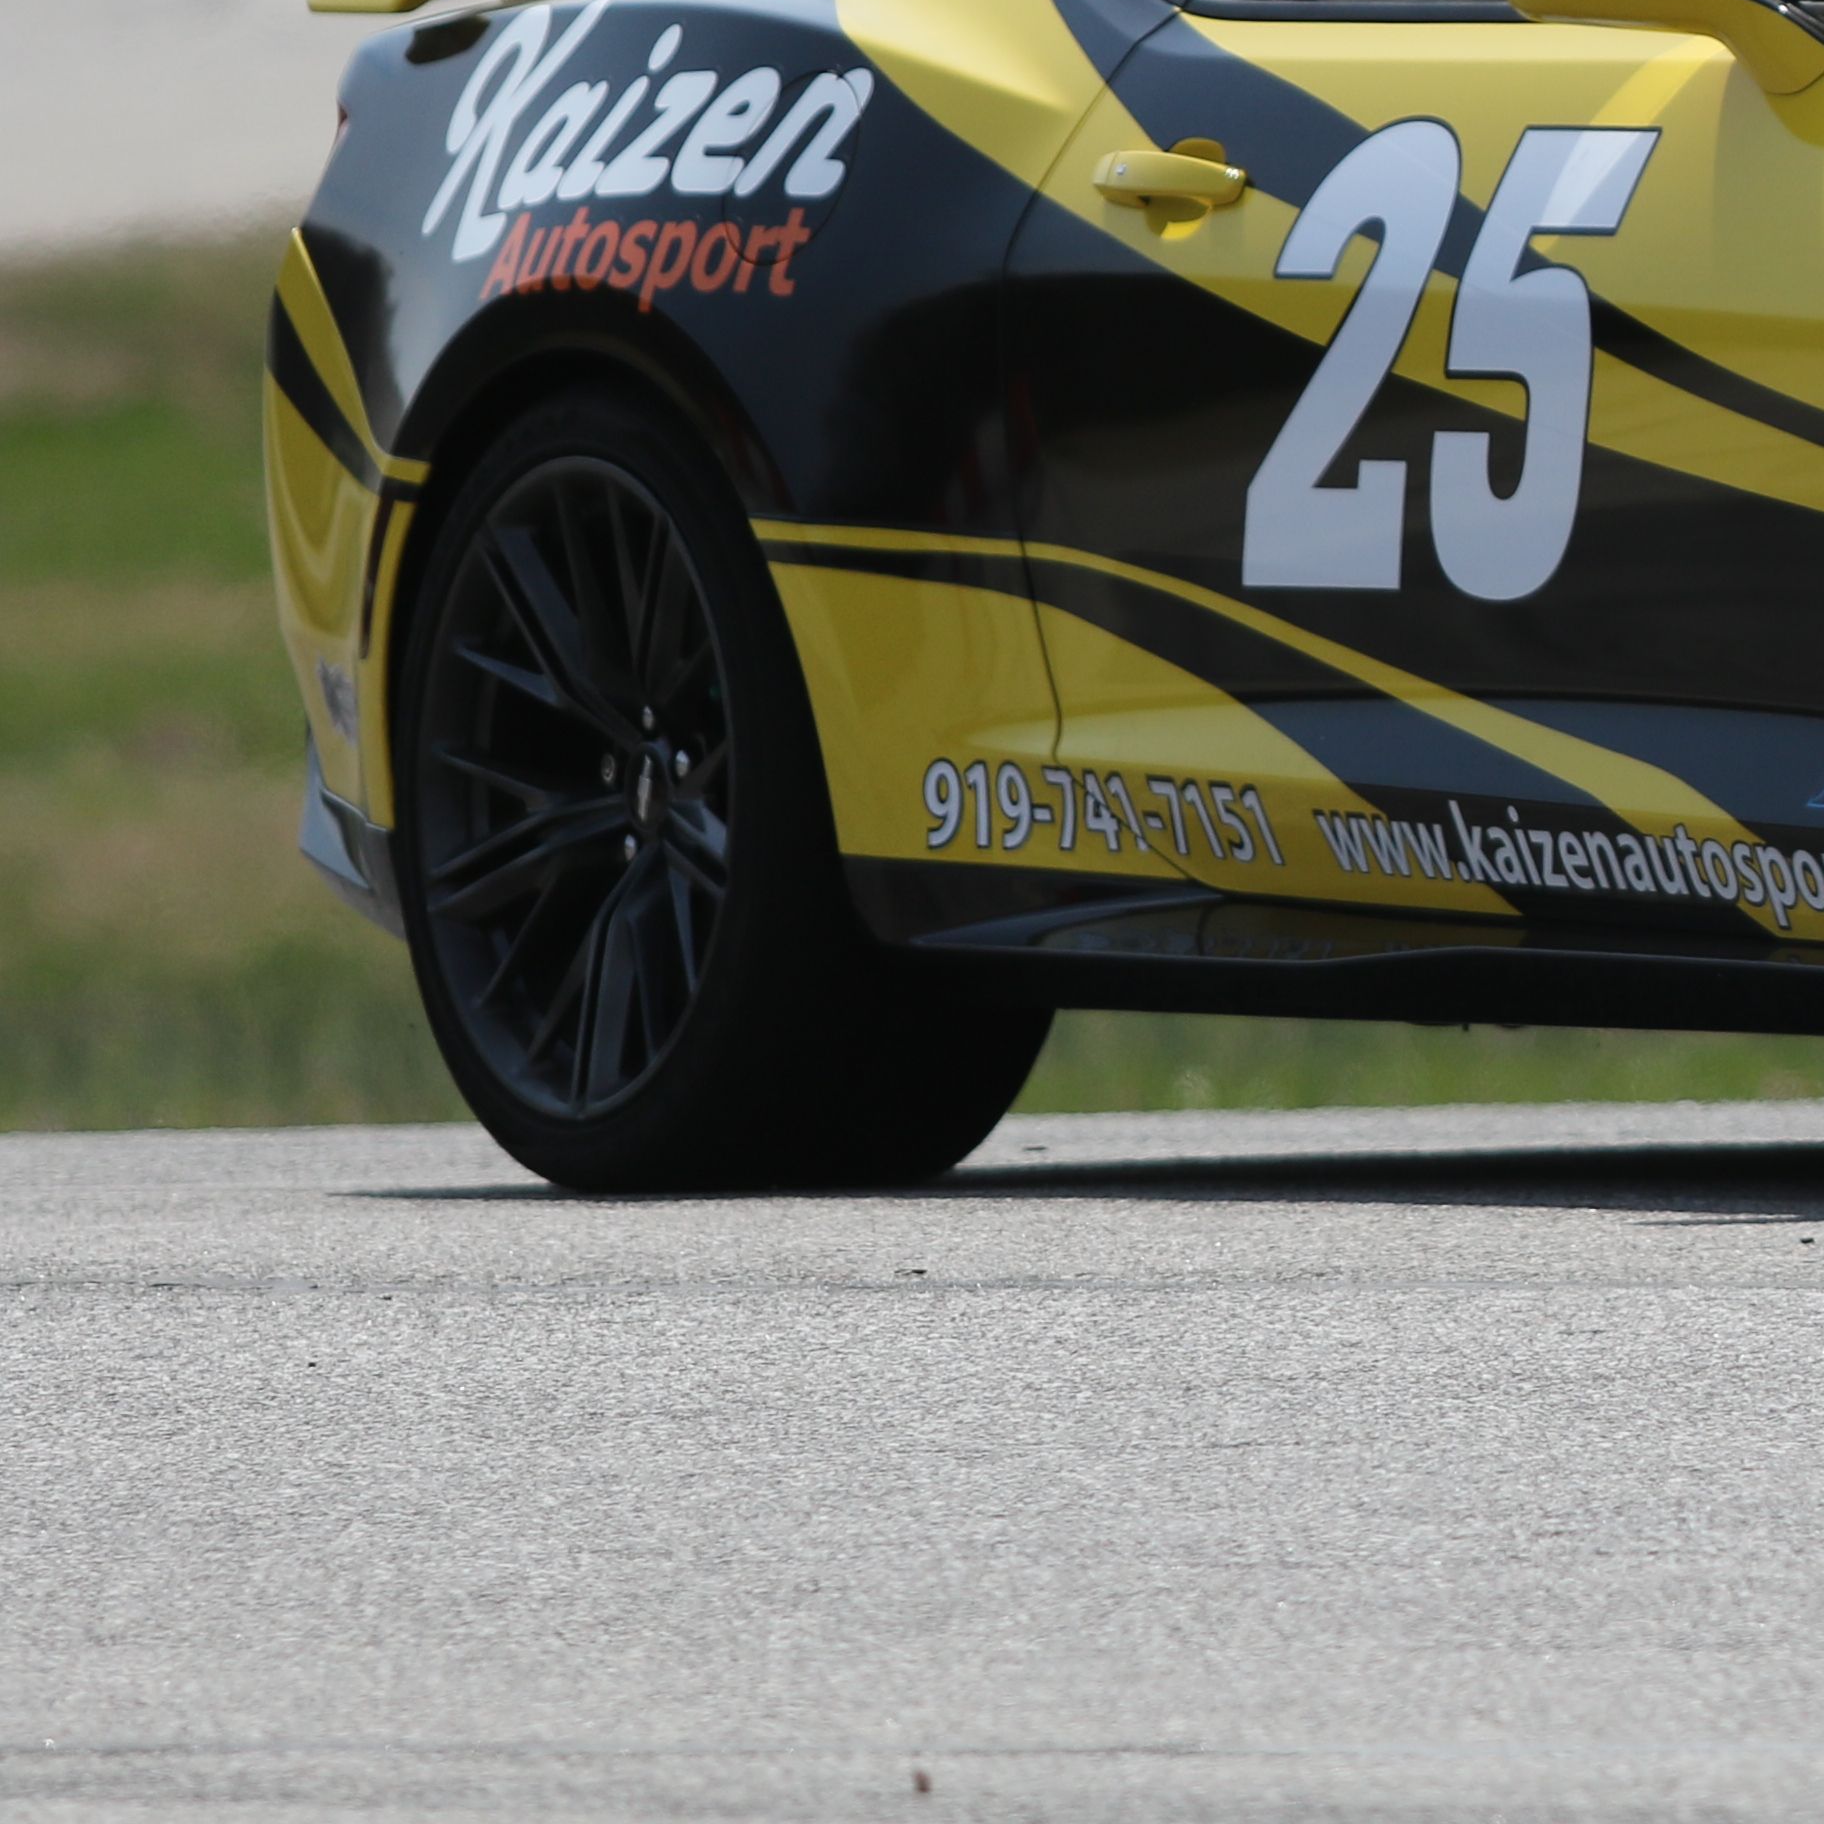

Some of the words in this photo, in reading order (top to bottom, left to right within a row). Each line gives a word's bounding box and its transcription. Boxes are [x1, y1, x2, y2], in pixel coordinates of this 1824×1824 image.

[481, 206, 811, 313] Autosport
[1242, 115, 1662, 602] 25
[922, 757, 1285, 866] 919-741-7151
